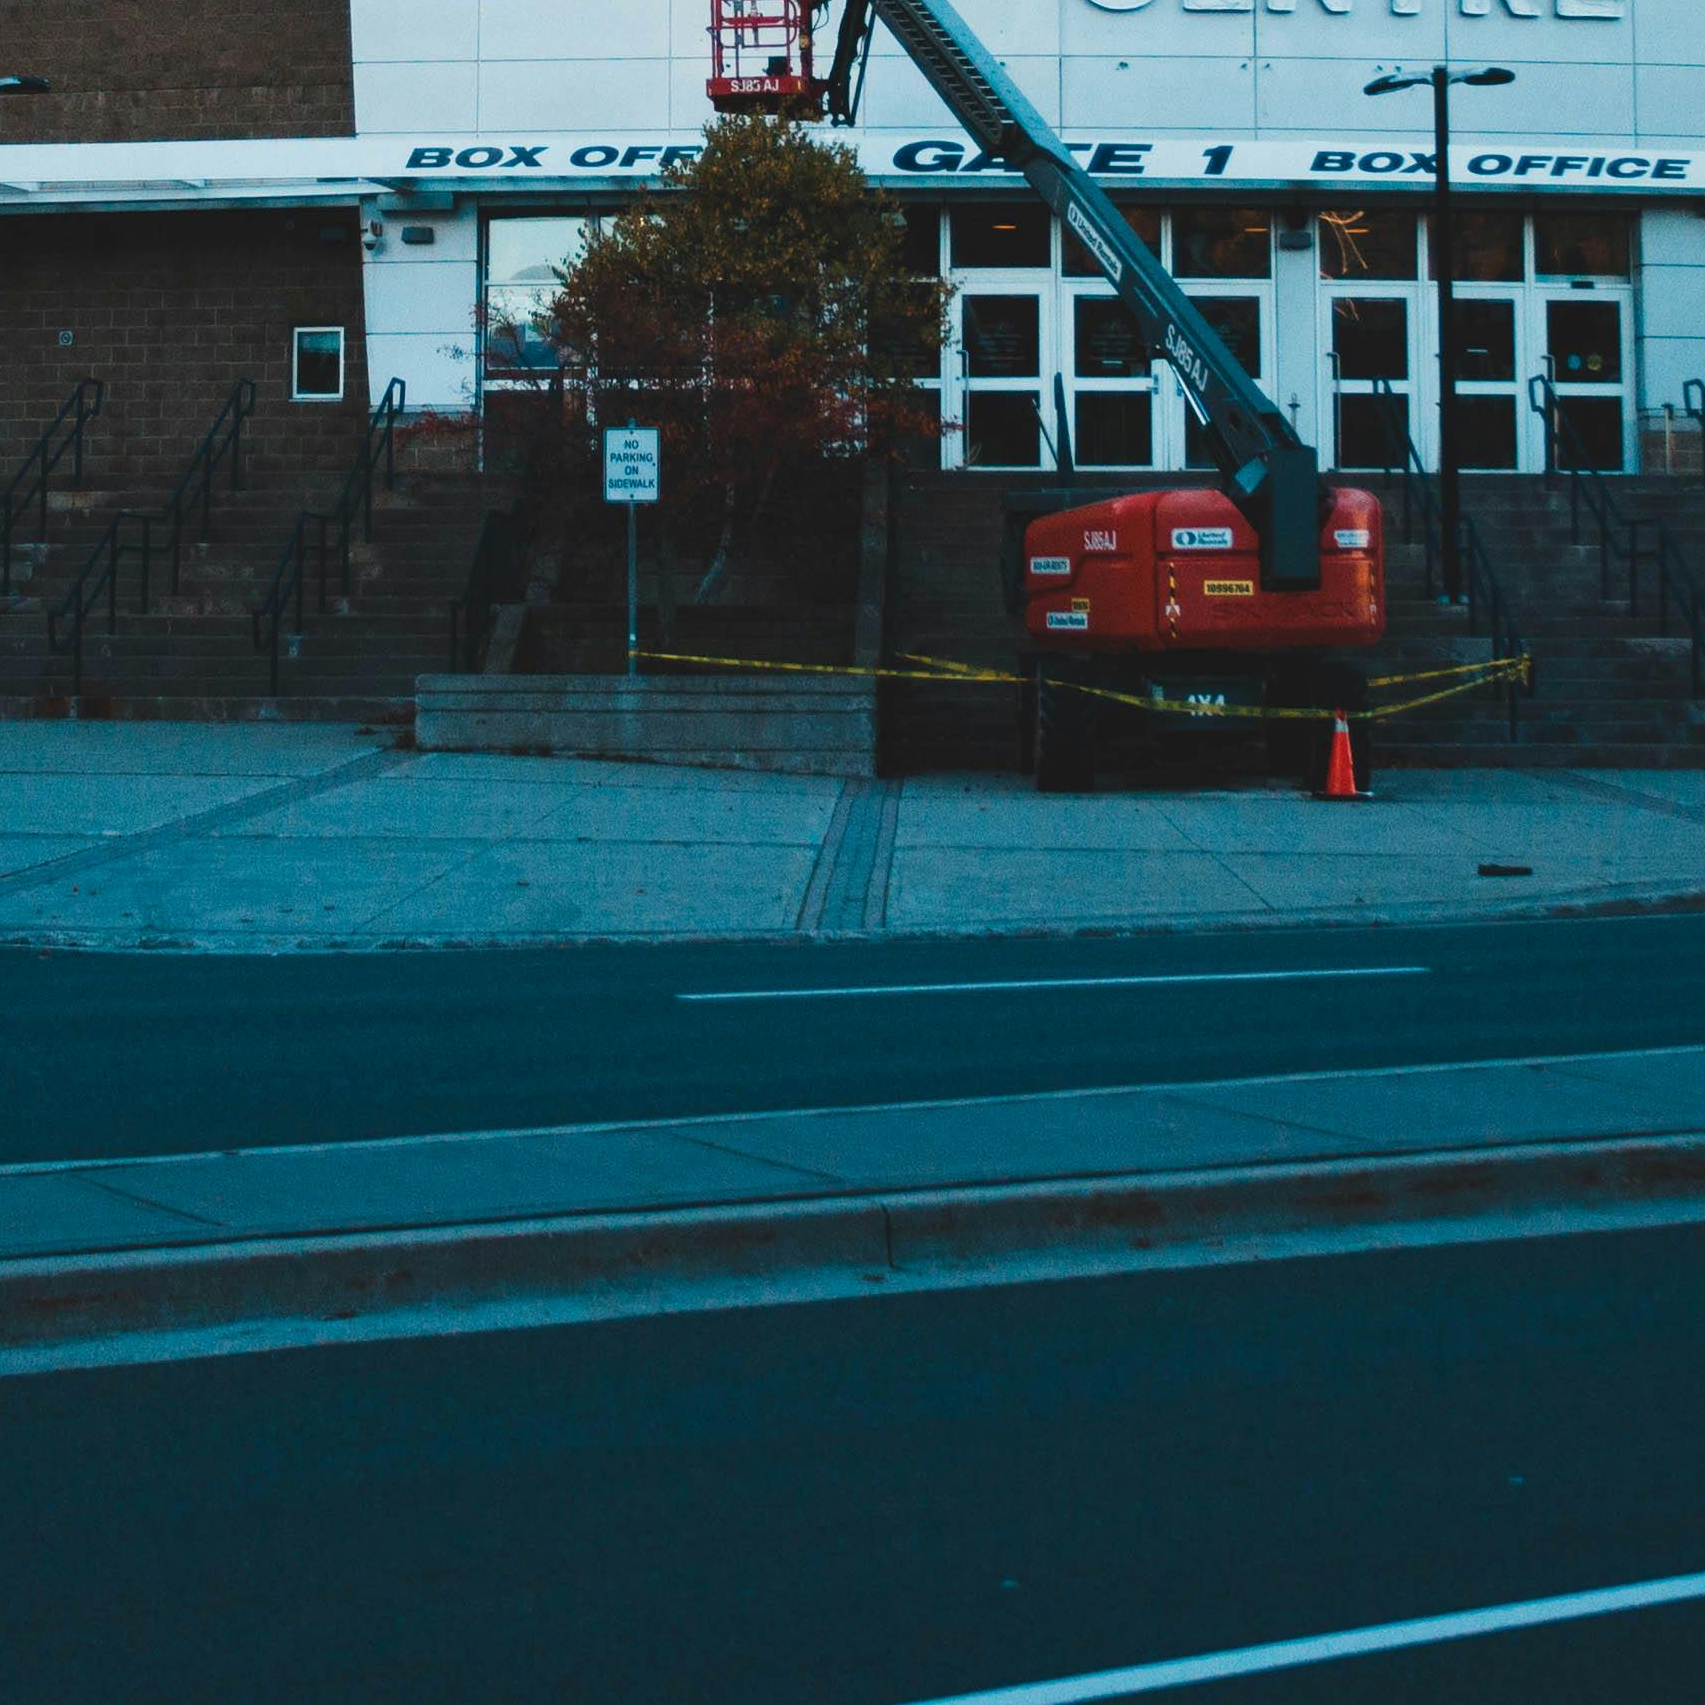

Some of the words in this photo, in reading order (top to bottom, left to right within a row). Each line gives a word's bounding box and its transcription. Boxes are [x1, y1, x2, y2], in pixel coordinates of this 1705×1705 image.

[405, 146, 548, 168] BOX
[570, 146, 703, 168] OFF
[892, 140, 1153, 174] GAE
[1201, 145, 1234, 175] 1
[1310, 151, 1439, 173] BOX
[1467, 154, 1691, 179] OFFICE
[624, 439, 639, 449] NO
[610, 452, 653, 462] PARKING
[624, 465, 639, 475] ON
[608, 478, 655, 488] SIDEWALK
